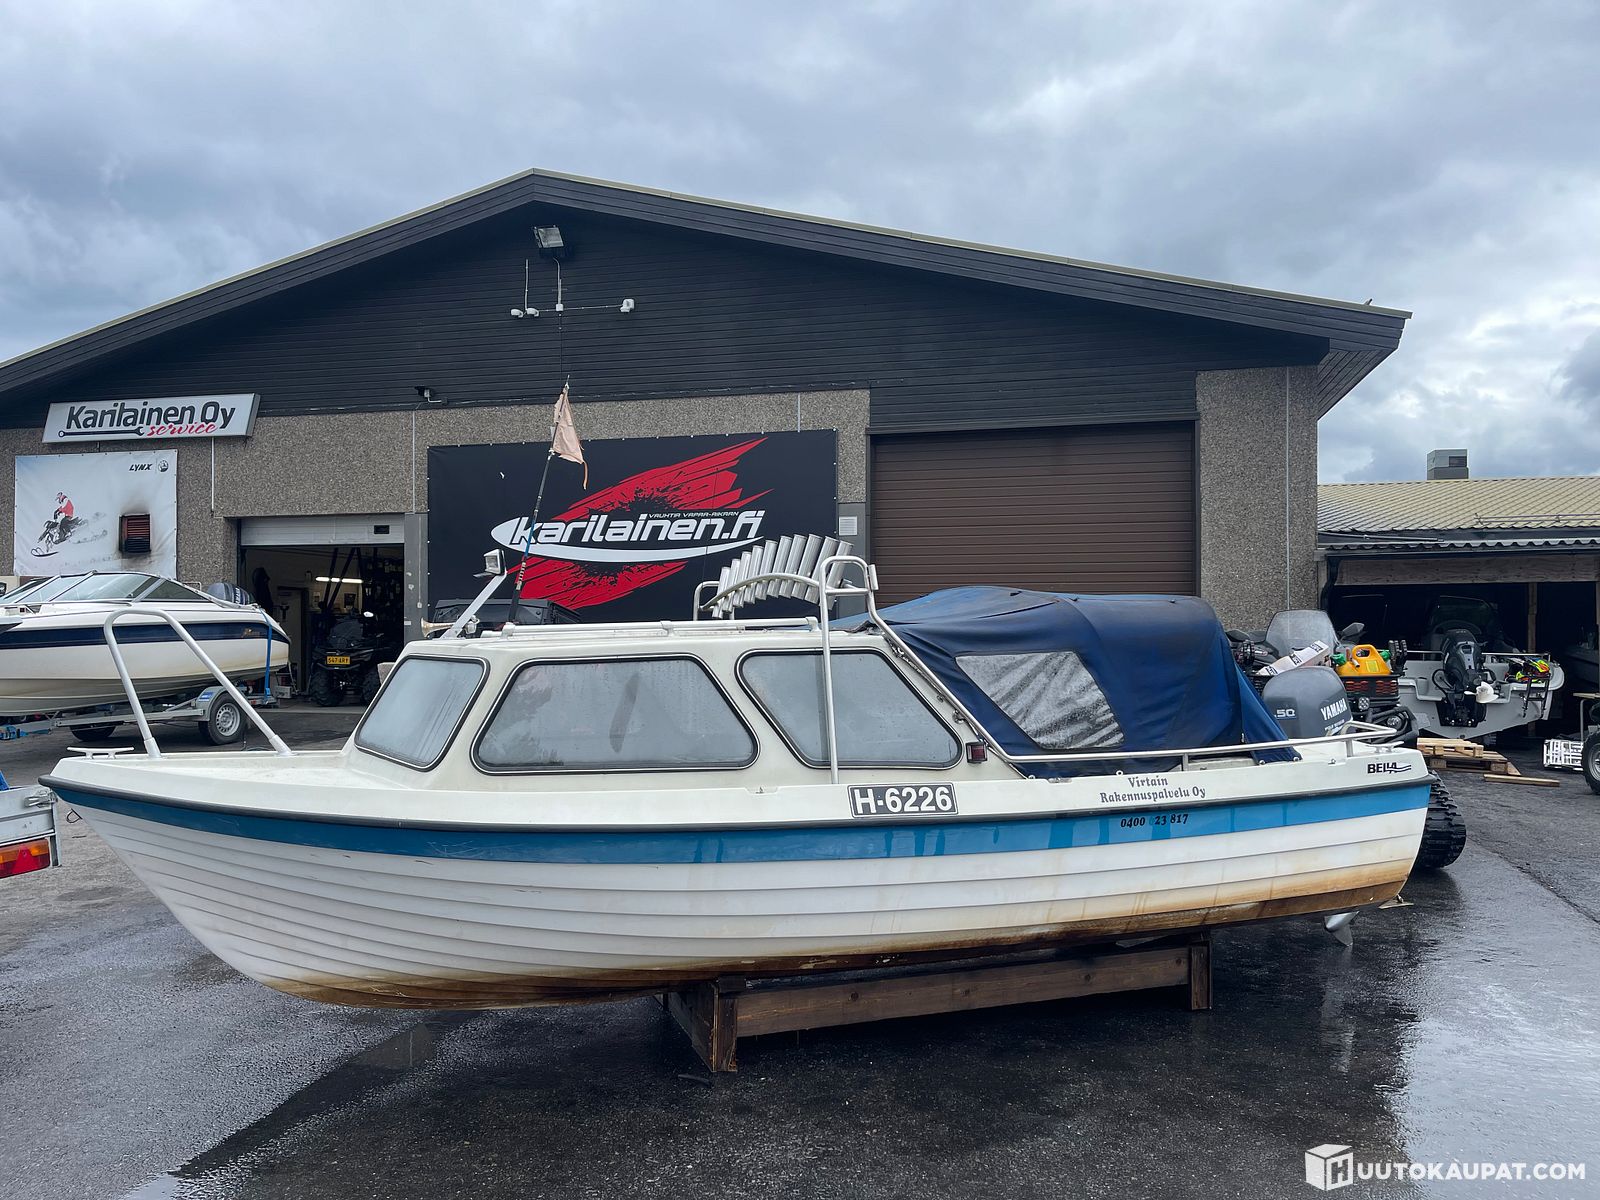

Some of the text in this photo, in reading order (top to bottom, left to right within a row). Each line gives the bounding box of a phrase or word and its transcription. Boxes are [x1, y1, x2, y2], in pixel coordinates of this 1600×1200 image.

[66, 401, 236, 429] Karilainen Oy
[147, 422, 218, 437] service
[129, 463, 153, 472] LYNX
[511, 510, 765, 544] karilainen.fi
[1320, 698, 1347, 721] YAMAHA
[1128, 775, 1168, 788] Virtain
[854, 786, 953, 814] H-6226
[1100, 786, 1206, 803] Rakennuspalvelu Oy
[1120, 817, 1146, 828] 0400
[1170, 813, 1189, 824] 817
